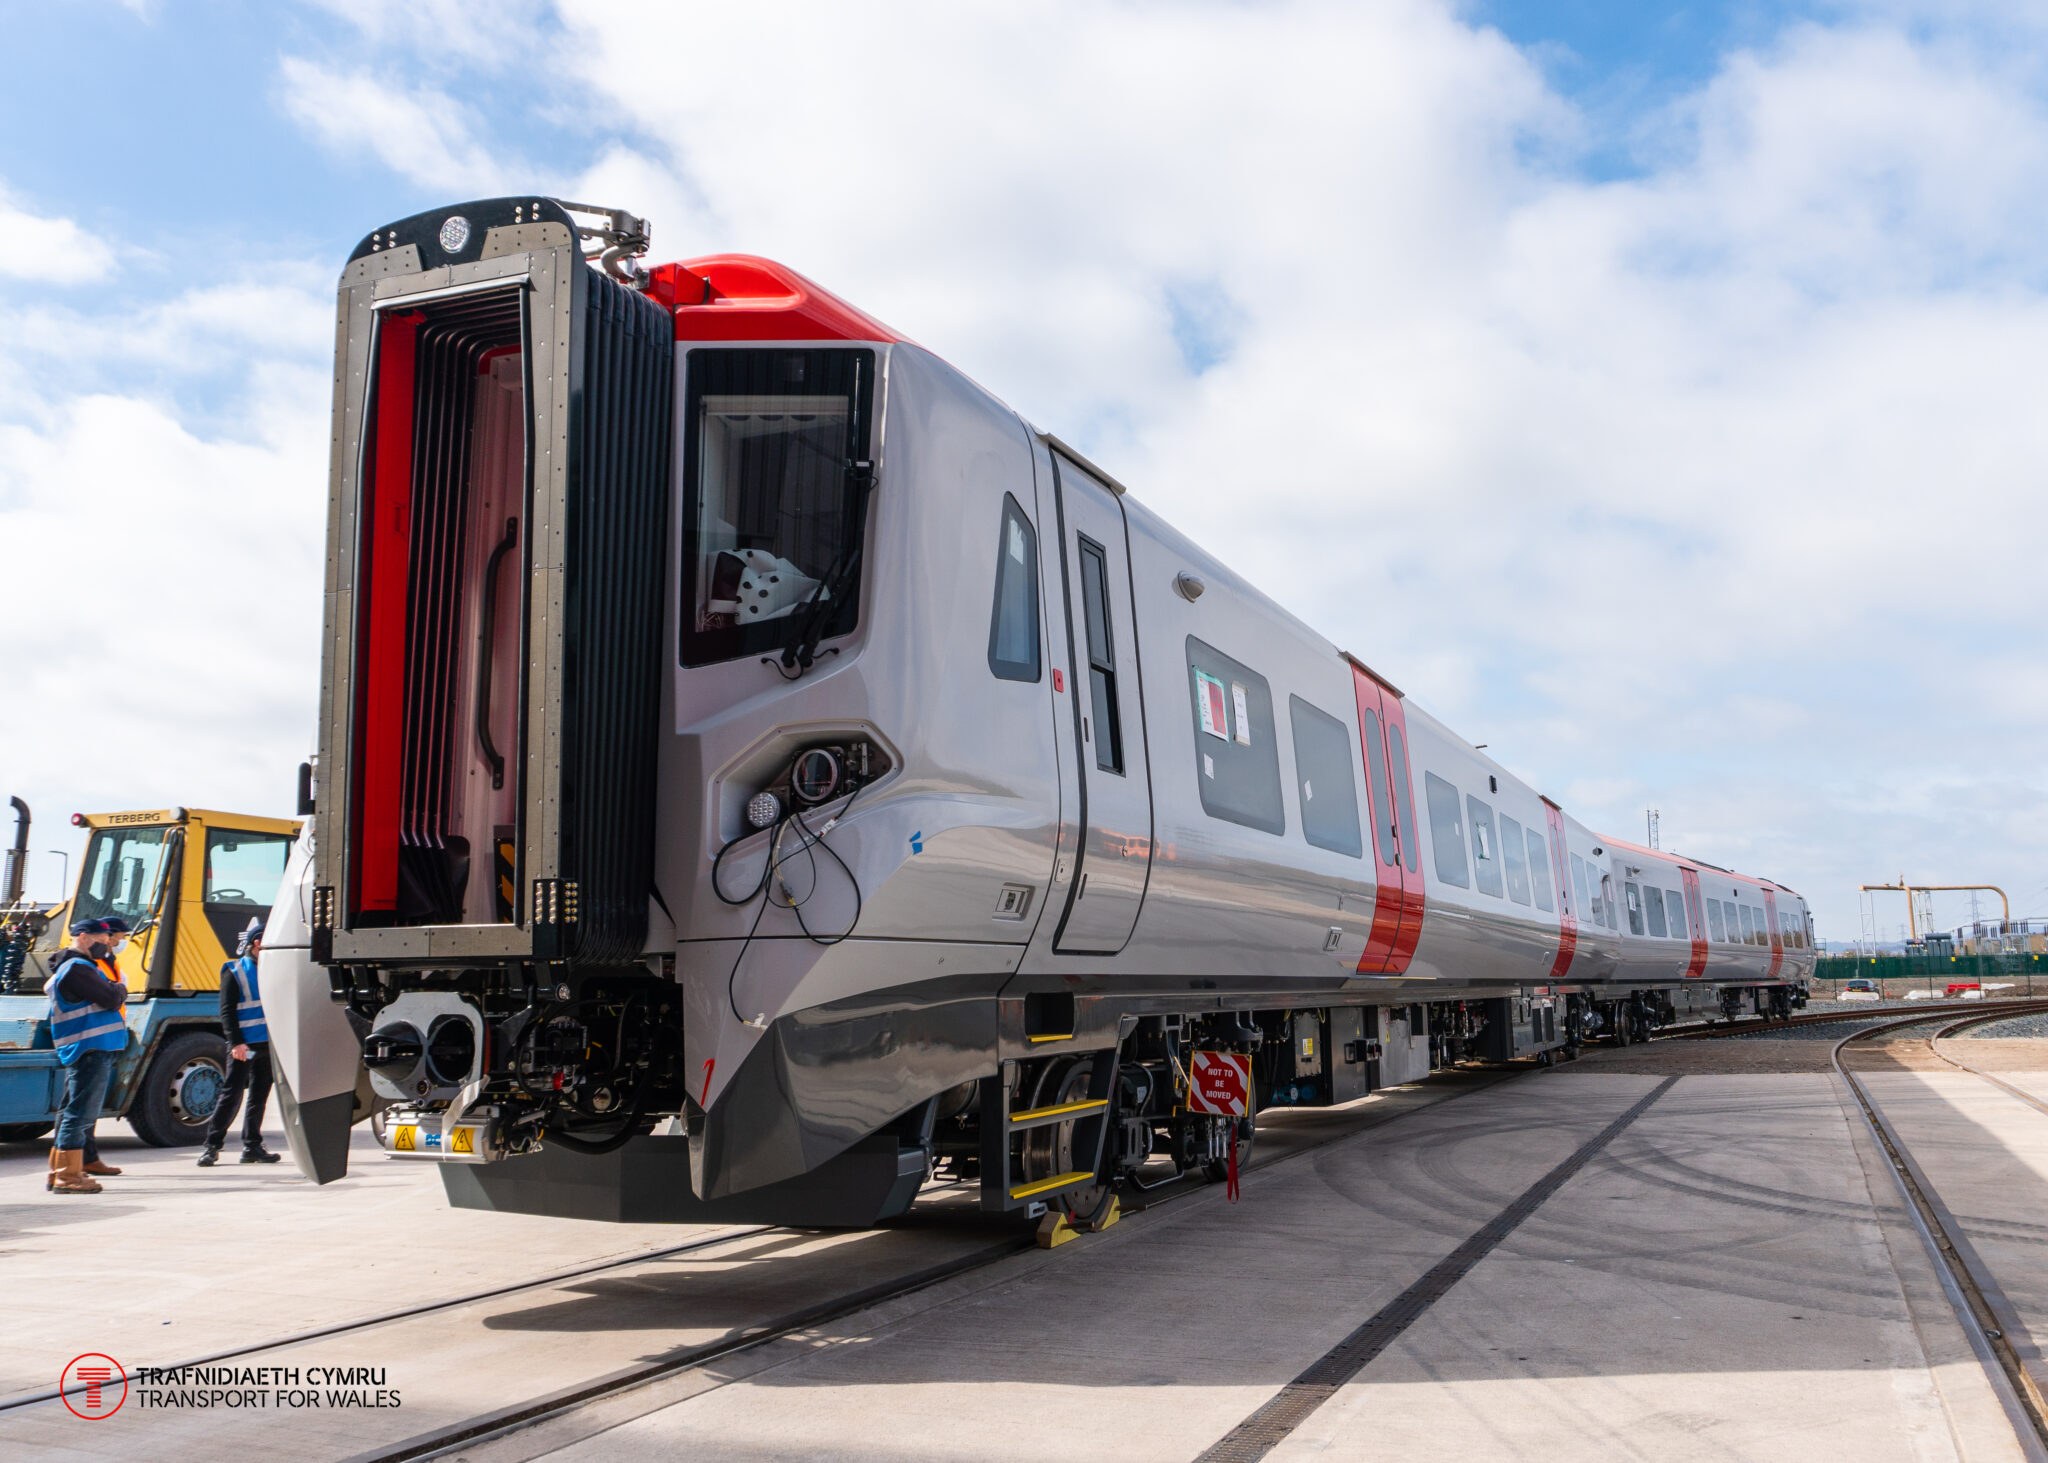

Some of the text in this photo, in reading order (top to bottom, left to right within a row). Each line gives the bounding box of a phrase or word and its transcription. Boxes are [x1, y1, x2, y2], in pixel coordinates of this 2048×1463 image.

[108, 812, 160, 824] TERBERG
[1207, 1067, 1234, 1078] NOT TO
[1214, 1079, 1225, 1088] BE
[1206, 1090, 1231, 1100] MOVED
